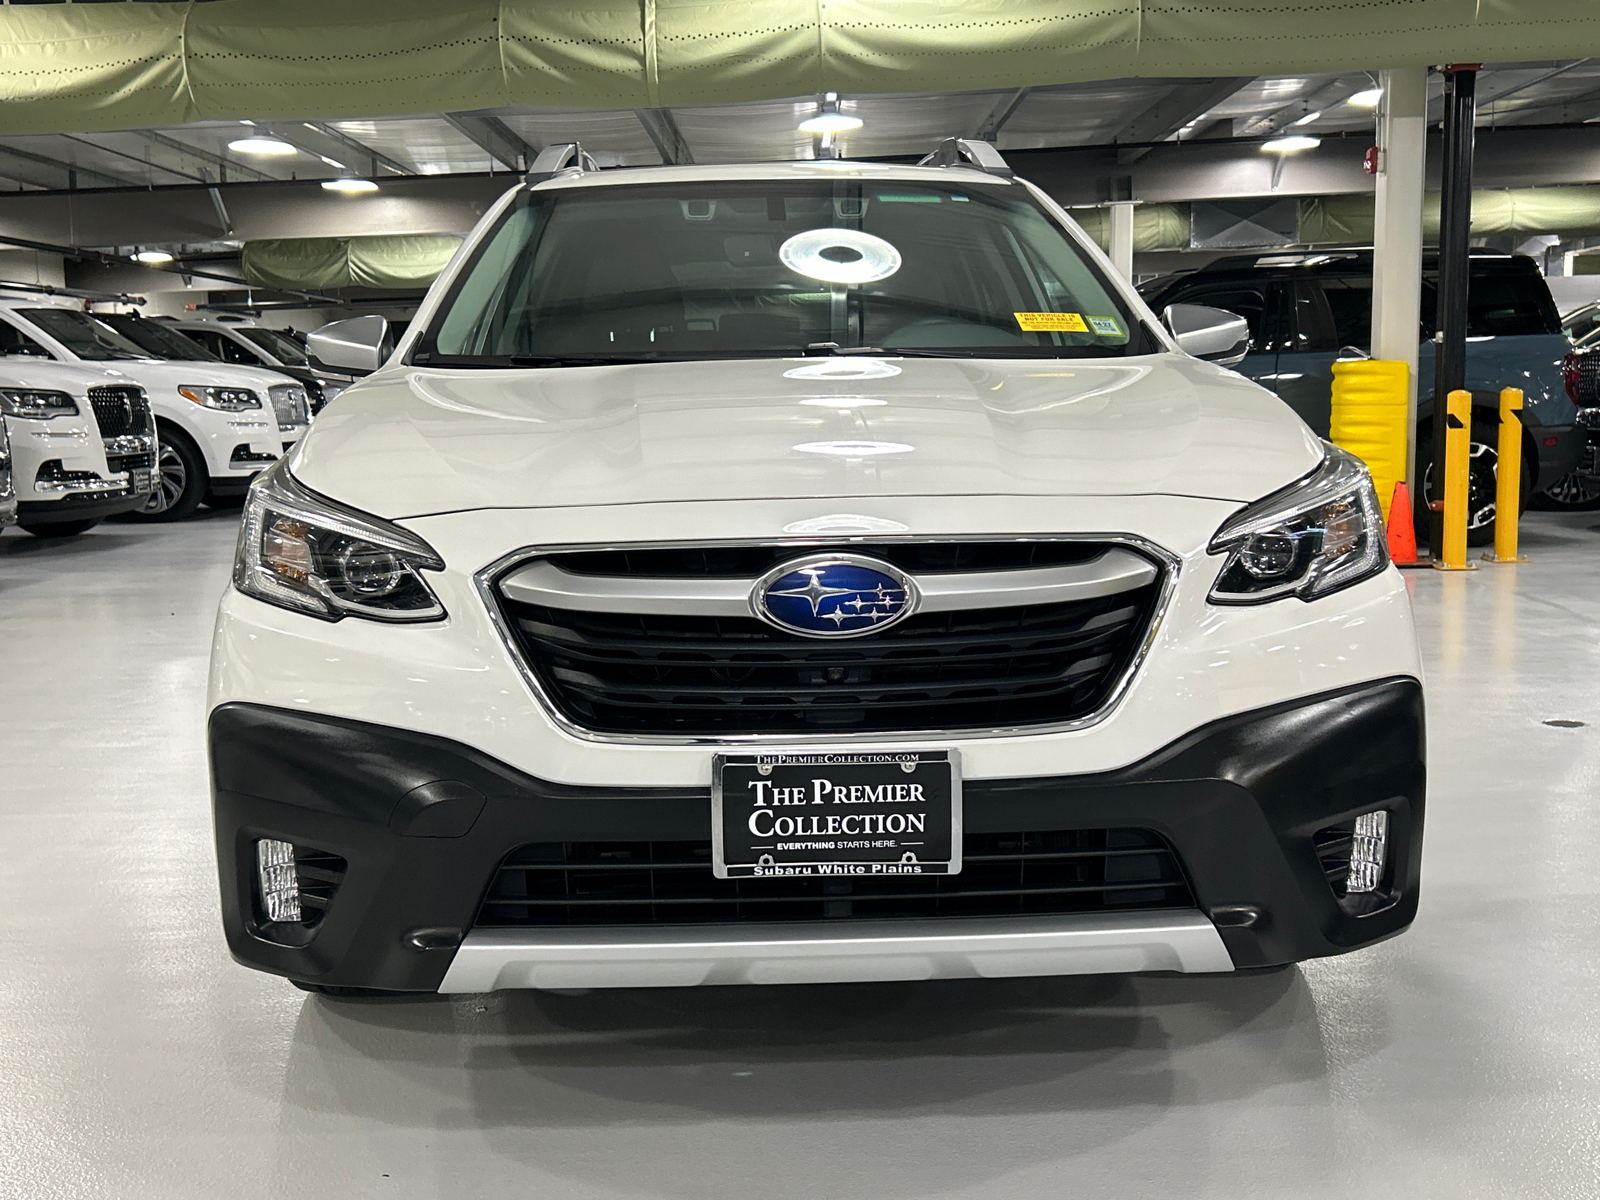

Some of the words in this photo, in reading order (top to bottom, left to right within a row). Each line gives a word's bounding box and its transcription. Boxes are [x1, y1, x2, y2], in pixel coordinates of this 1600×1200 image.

[748, 780, 806, 807] THE
[811, 779, 926, 805] PREMIER
[748, 809, 926, 837] COLLECTION
[777, 841, 835, 850] EVERYTHING
[837, 840, 870, 849] STARTS
[871, 839, 897, 848] HERE.
[753, 866, 812, 876] Subaru
[817, 864, 866, 874] White
[871, 864, 922, 874] Plains
